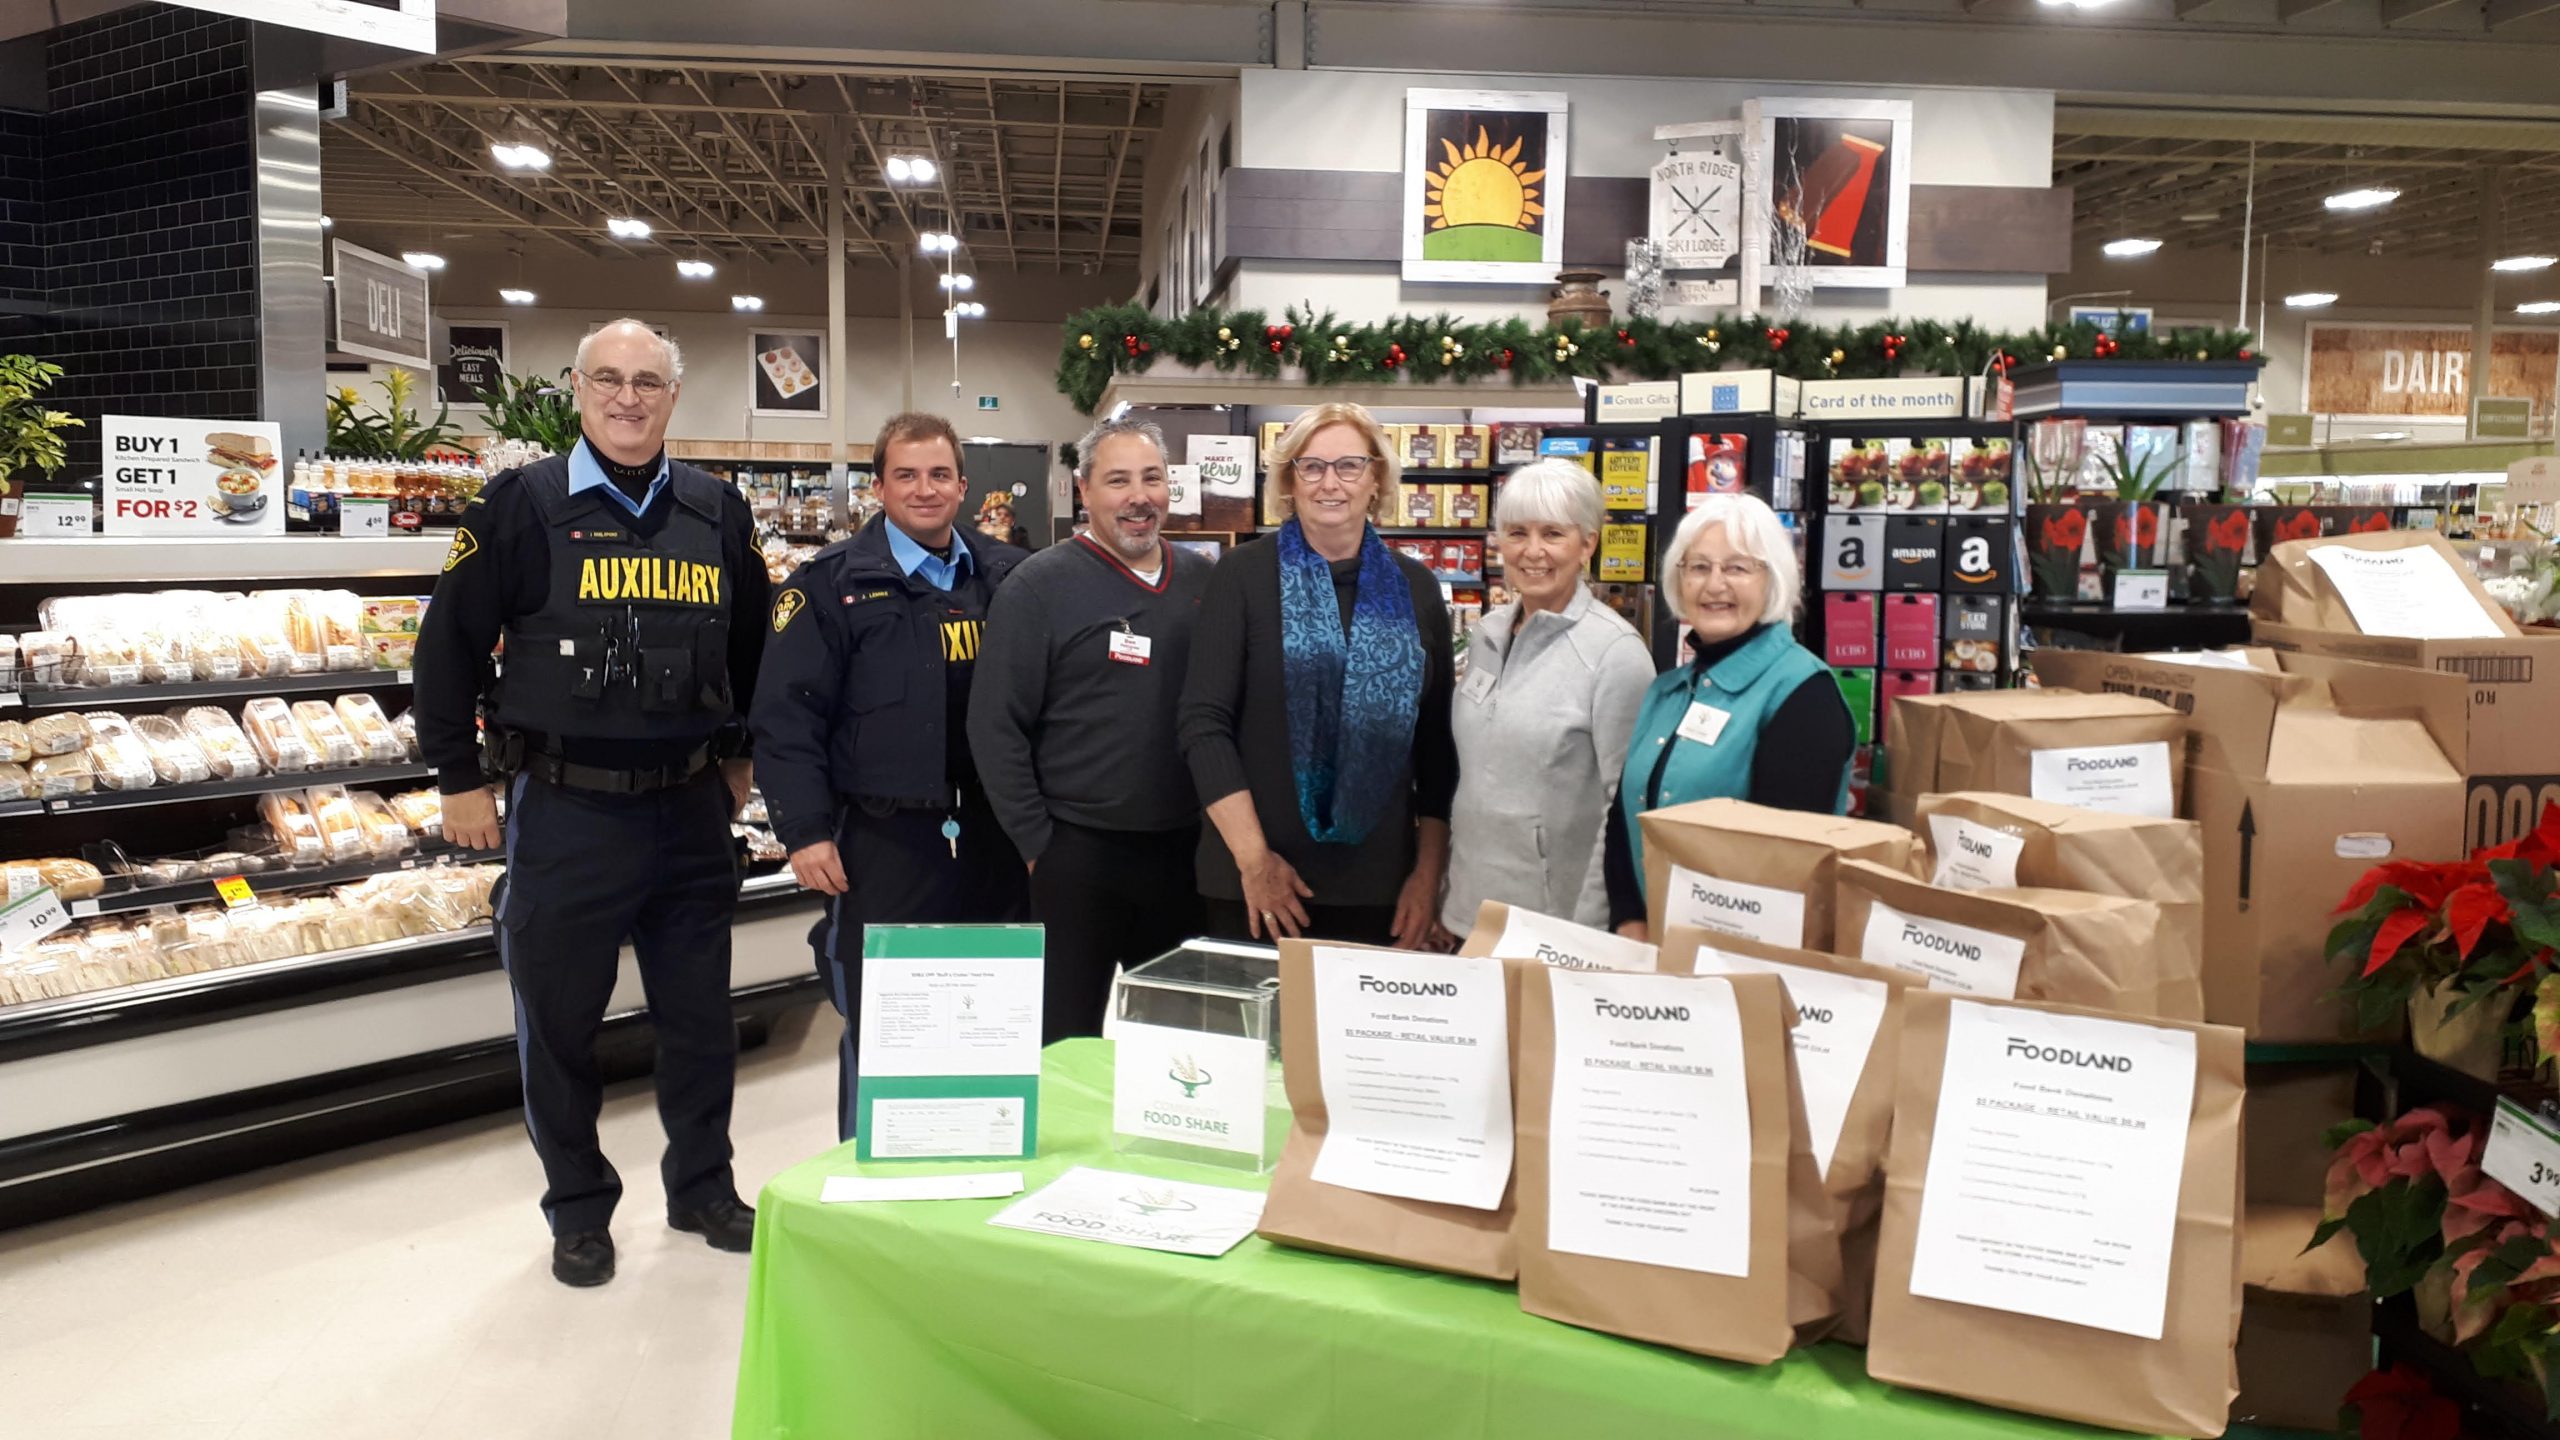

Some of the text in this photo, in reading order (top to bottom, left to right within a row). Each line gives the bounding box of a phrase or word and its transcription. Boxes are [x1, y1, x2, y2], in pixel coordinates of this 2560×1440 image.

[1657, 161, 1736, 182] NORTH RIDGE
[1692, 240, 1727, 252] LODGE
[1687, 283, 1724, 293] TRAILS
[368, 278, 401, 339] DELI
[462, 363, 480, 373] EASY
[2383, 350, 2464, 395] DAIR
[459, 374, 484, 384] MEALS
[1616, 394, 1670, 405] Great Gifts
[1809, 392, 1955, 409] Card of the month
[116, 436, 178, 454] BUY 1
[116, 467, 176, 484] GET 1
[1196, 461, 1242, 485] merry
[117, 499, 198, 518] FOR $2
[1838, 536, 1866, 569] a
[1892, 547, 1936, 560] amazon
[1960, 536, 1991, 573] a
[578, 557, 721, 605] AUXILIARY
[1835, 645, 1867, 657] LCBO
[1894, 648, 1926, 660] LCBO
[2067, 756, 2138, 771] FOODLAND
[1692, 883, 1761, 914] FOODLAND
[1903, 923, 1982, 961] FOODLAND
[1359, 974, 1458, 998] FOODLAND
[1371, 1012, 1390, 1020] Food
[1412, 1015, 1449, 1024] Donations
[1594, 998, 1690, 1021] FOODLAND
[1355, 1029, 1393, 1039] PACKAGE
[1401, 1032, 1427, 1041] RETAIL
[1430, 1034, 1456, 1043] VALUE
[1609, 1039, 1684, 1052] Food Bank Donations
[1594, 1058, 1631, 1069] PACKAGE
[2007, 1037, 2132, 1073] FOODLAND
[2013, 1081, 2114, 1102] Food Bank Donations
[1989, 1099, 2036, 1113] PACKAGE
[1144, 1110, 1182, 1128] FOOD
[1185, 1116, 1230, 1135] SHARE
[1034, 1211, 1196, 1244] FOOD SHARE
